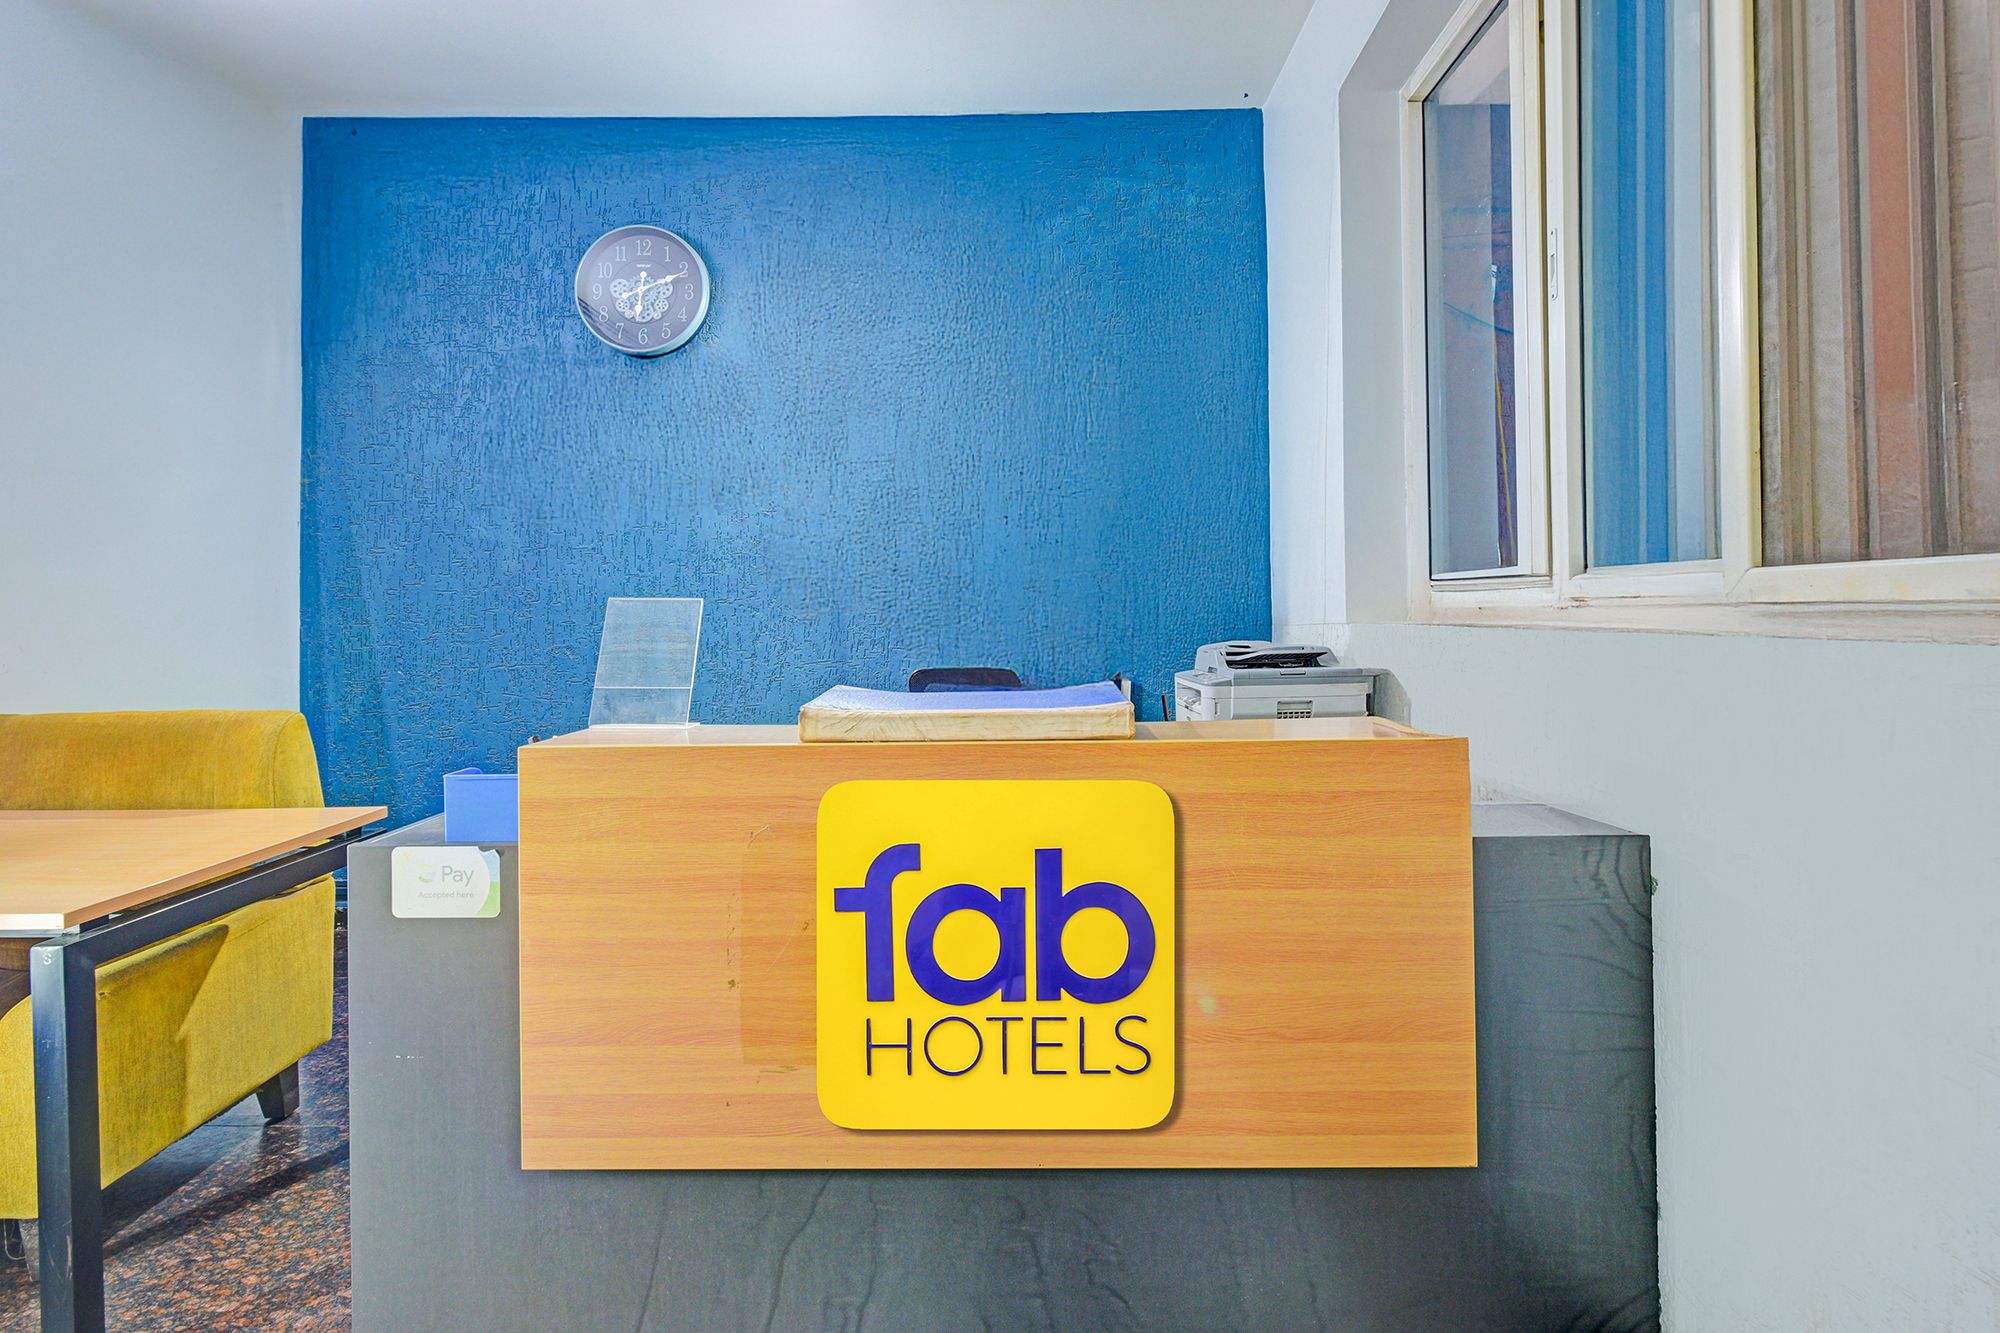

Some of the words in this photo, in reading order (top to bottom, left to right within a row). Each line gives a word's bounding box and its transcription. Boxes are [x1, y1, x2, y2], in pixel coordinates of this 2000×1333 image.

[615, 246, 627, 262] 11
[635, 239, 652, 256] 12
[664, 246, 671, 262] 1
[598, 262, 612, 278] 10
[679, 262, 689, 278] 2
[592, 283, 602, 300] 9
[684, 284, 694, 300] 3
[599, 305, 609, 322] 8
[677, 306, 687, 322] 4
[615, 322, 624, 339] 7
[638, 328, 648, 344] 6
[661, 322, 671, 339] 5
[441, 865, 474, 887] Pay
[834, 842, 1156, 1006] fab
[866, 1015, 1151, 1076] HOTELS
